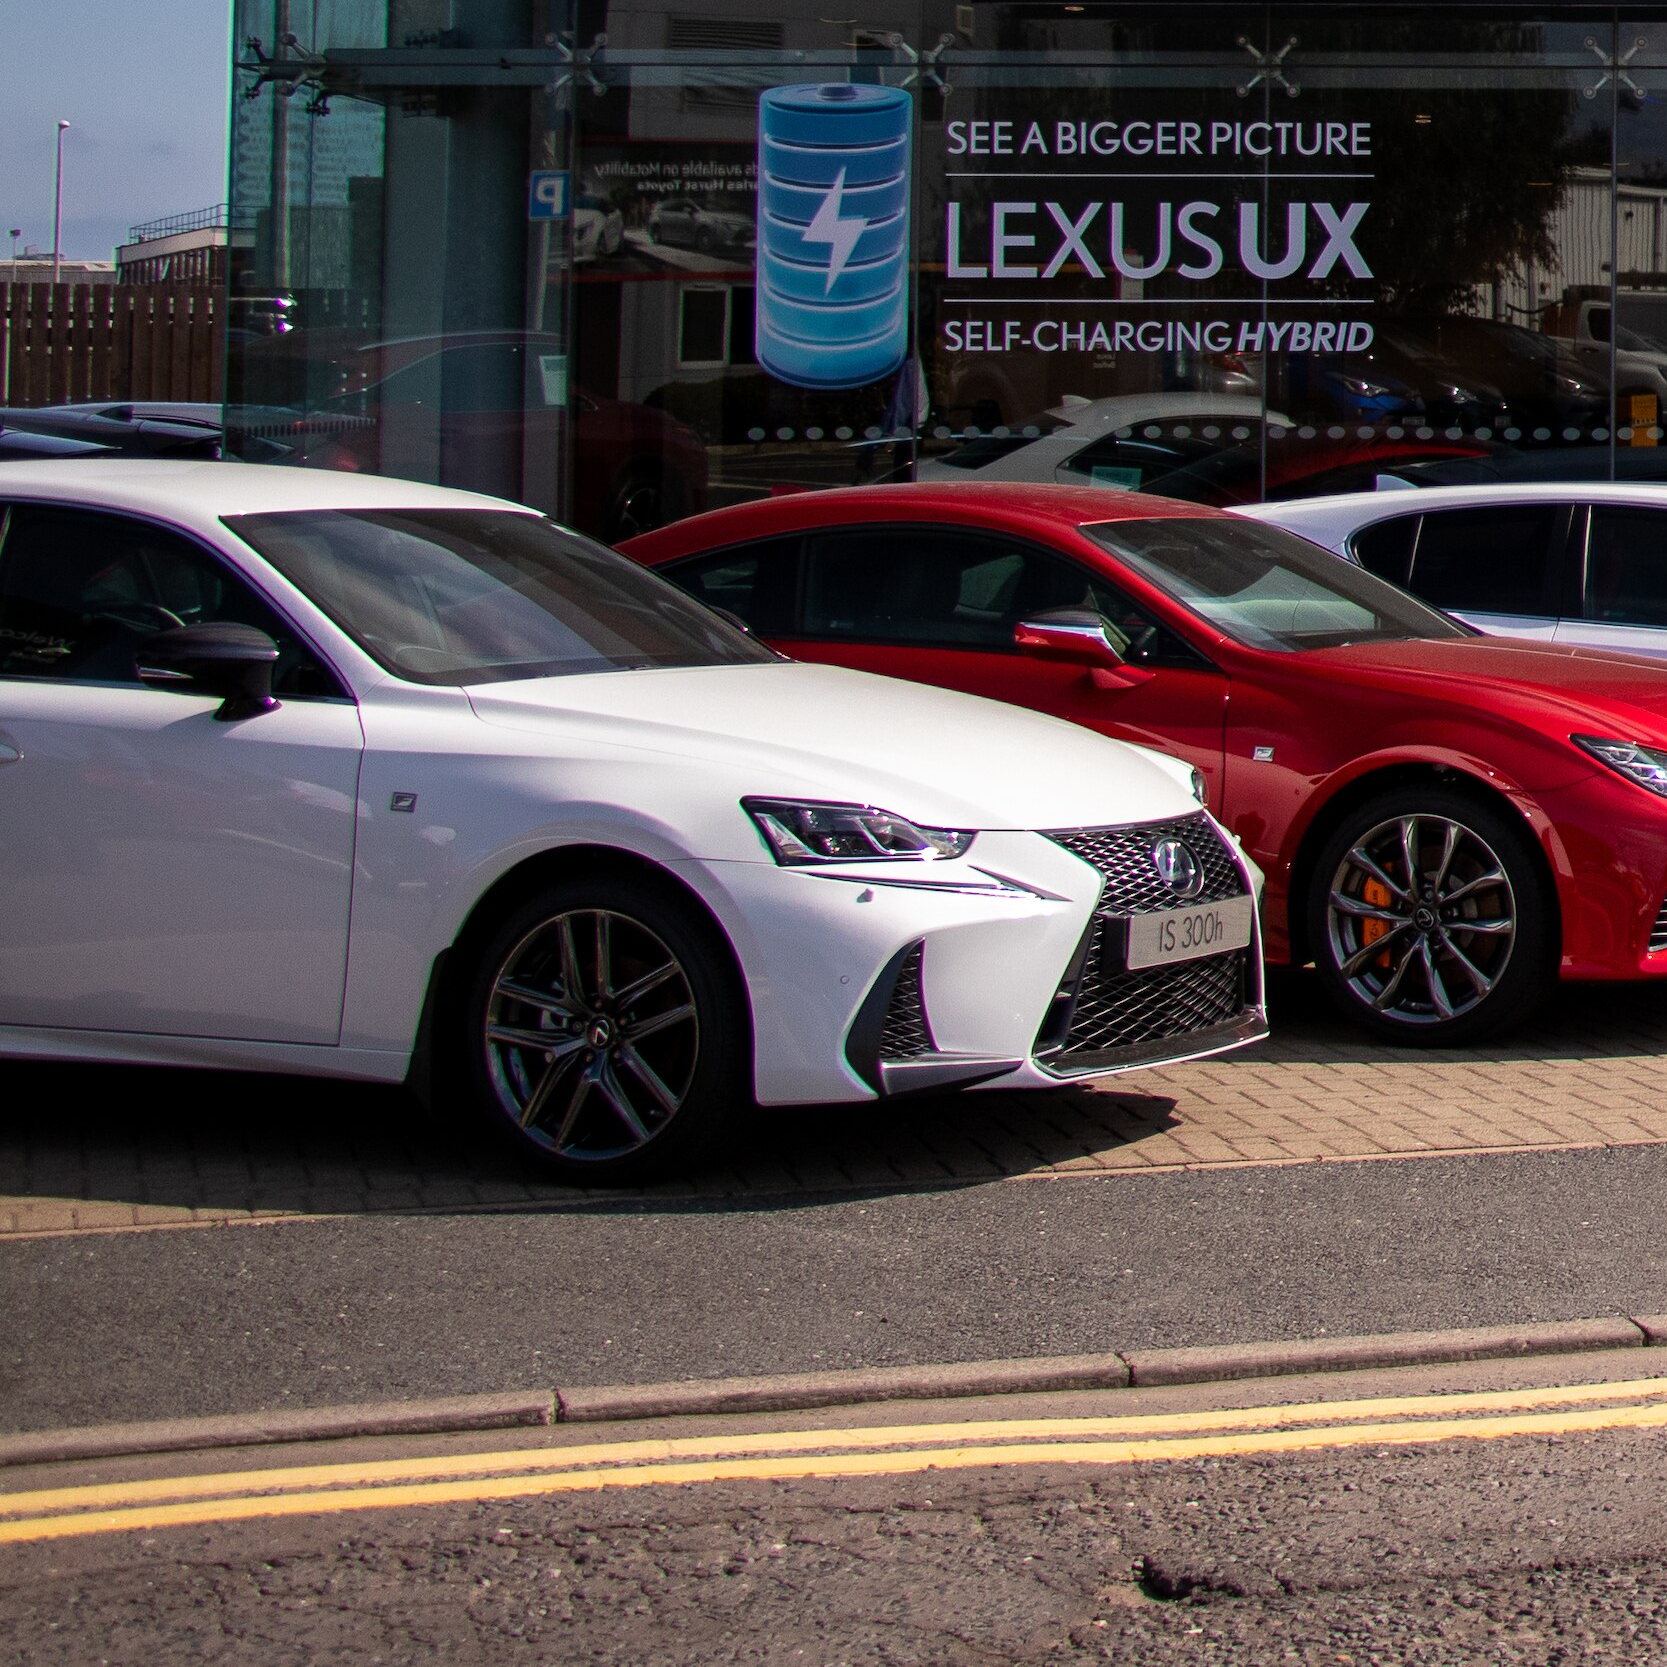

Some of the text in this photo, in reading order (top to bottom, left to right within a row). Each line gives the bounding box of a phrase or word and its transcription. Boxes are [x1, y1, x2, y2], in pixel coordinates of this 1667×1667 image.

[947, 121, 1371, 155] SEE A BIGGER PICTURE
[946, 201, 1374, 279] LEXUS UX
[944, 320, 1374, 352] SELF-CHARGING HYBRID
[1159, 910, 1223, 952] IS 300h
